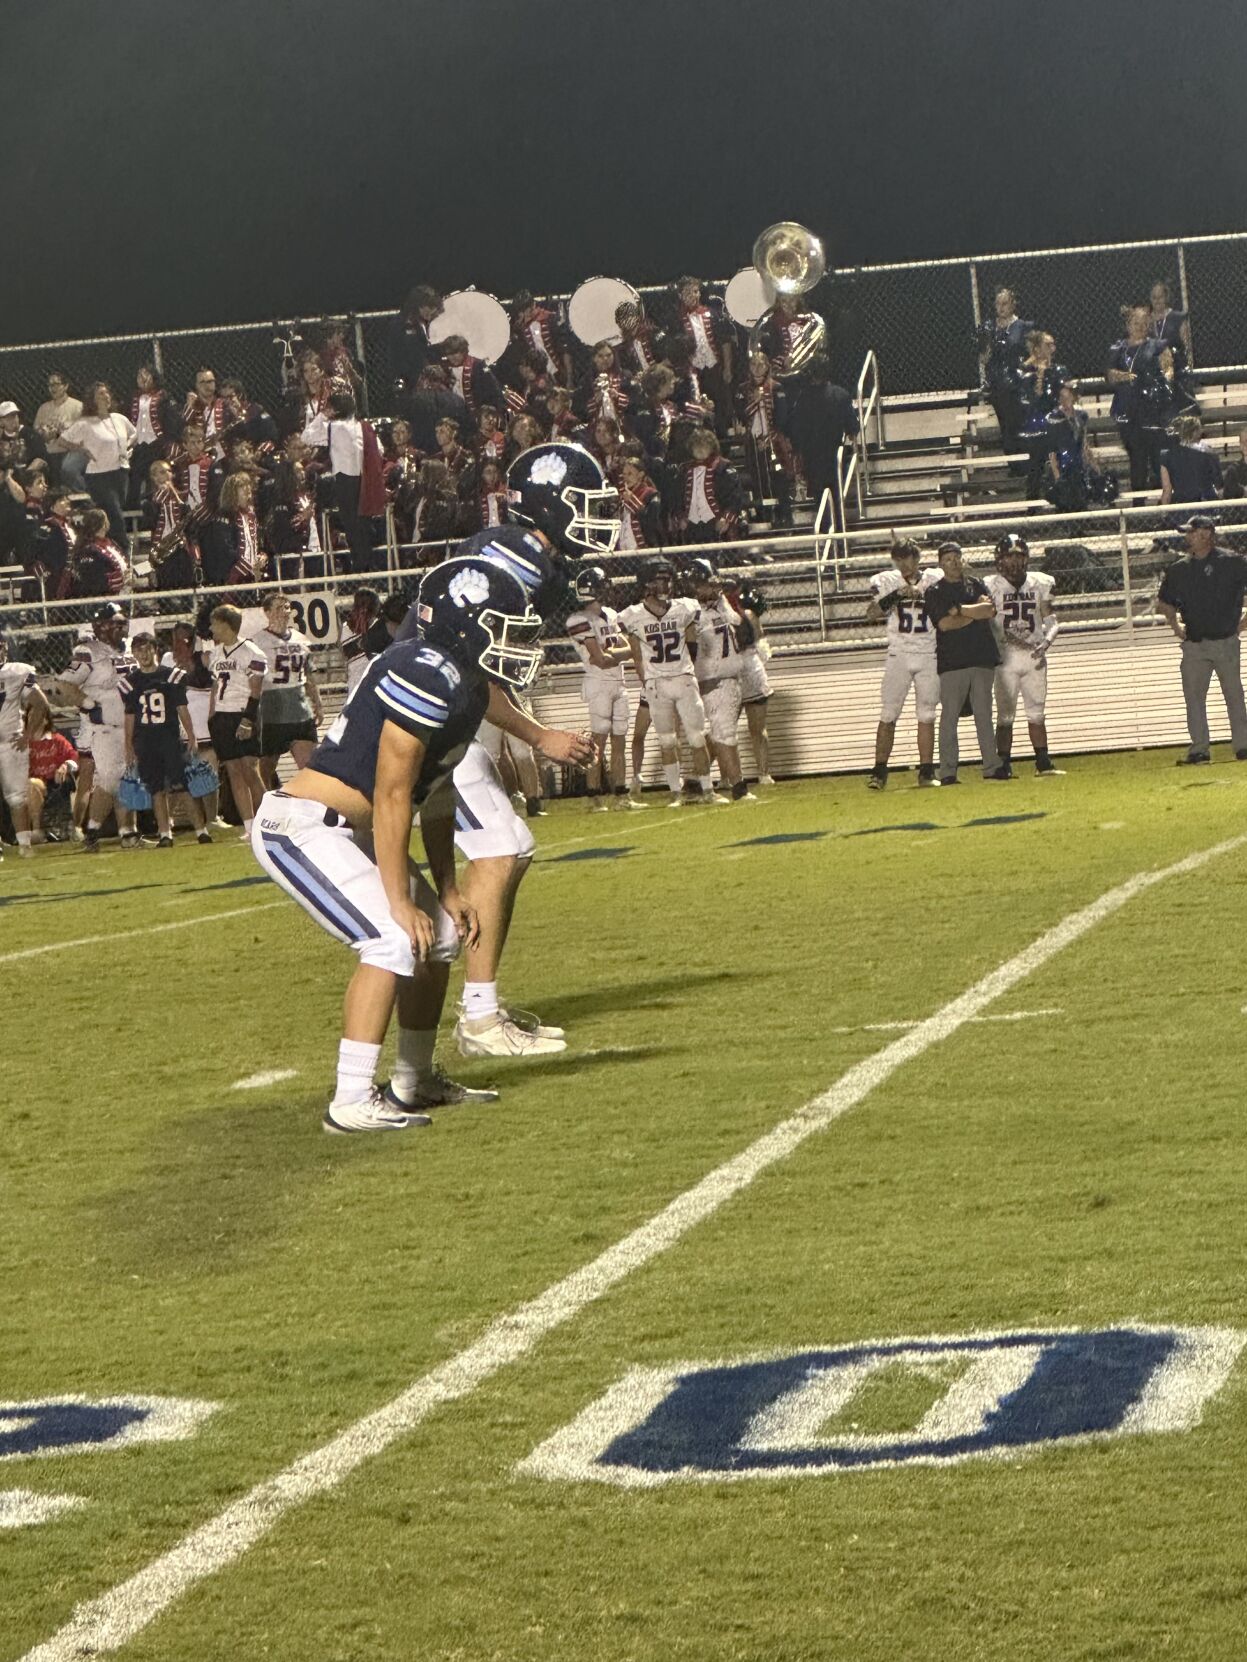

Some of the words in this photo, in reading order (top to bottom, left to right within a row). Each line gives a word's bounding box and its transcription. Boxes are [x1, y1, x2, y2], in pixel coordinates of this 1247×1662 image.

[290, 598, 330, 638] 30
[898, 600, 928, 633] 63
[1003, 602, 1036, 633] 25
[646, 631, 681, 663] 32
[138, 692, 166, 724] 19
